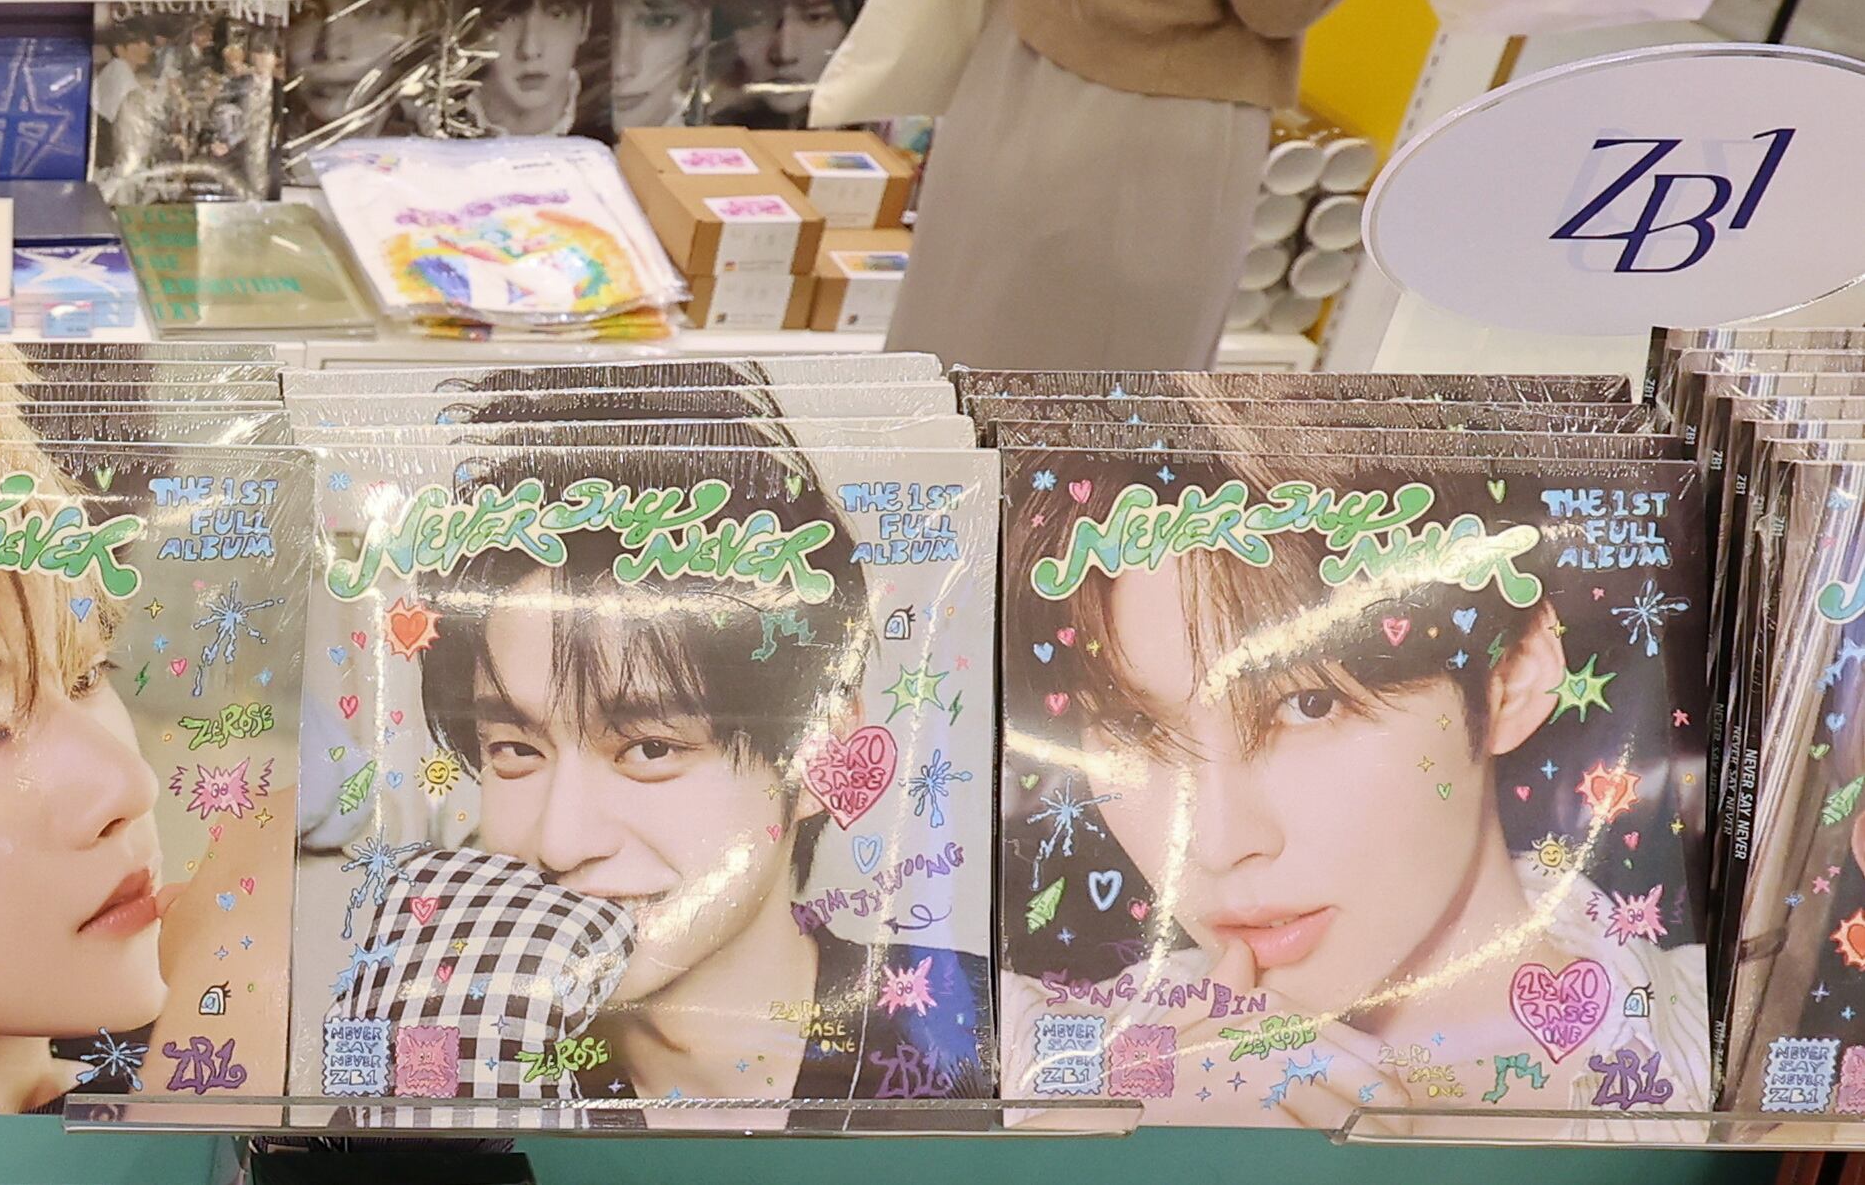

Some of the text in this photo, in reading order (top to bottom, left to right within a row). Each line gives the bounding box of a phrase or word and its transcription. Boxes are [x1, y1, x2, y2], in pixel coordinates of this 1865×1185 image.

[1549, 127, 1796, 274] ZB1
[1685, 424, 1697, 446] ZB1
[1711, 449, 1724, 471] ZB1
[150, 477, 277, 506] THE 1ST
[838, 483, 965, 512] THE 1ST
[1736, 474, 1747, 496] ZB1
[1540, 489, 1670, 518] THE 1ST
[190, 509, 272, 536] FULL
[878, 513, 959, 540] FULL
[1587, 518, 1665, 546] FULL
[158, 534, 275, 560] ALBUM
[325, 477, 565, 603] NEVER
[613, 510, 835, 604] NEVER
[851, 540, 963, 565] ALBUM
[1031, 480, 1272, 605] NEVER
[1556, 544, 1671, 569] ALBUM
[808, 767, 886, 797] BASE
[1734, 747, 1758, 861] NEVER SAY NEVER
[1517, 969, 1598, 1003] ZERO
[1520, 1002, 1600, 1029] BASE
[330, 1025, 382, 1041] NEVER
[1043, 1025, 1096, 1039] NEVER
[335, 1041, 379, 1054] SAY
[1048, 1038, 1093, 1052] SAY
[1775, 1045, 1830, 1061] NEVER
[330, 1055, 382, 1069] NEVER
[516, 1038, 611, 1079] ZEROSE
[1779, 1060, 1823, 1074] SAY
[329, 1068, 378, 1087] ZB1
[1042, 1067, 1092, 1085] ZB1
[1771, 1073, 1826, 1087] NEVER
[1768, 1087, 1819, 1105] ZB1
